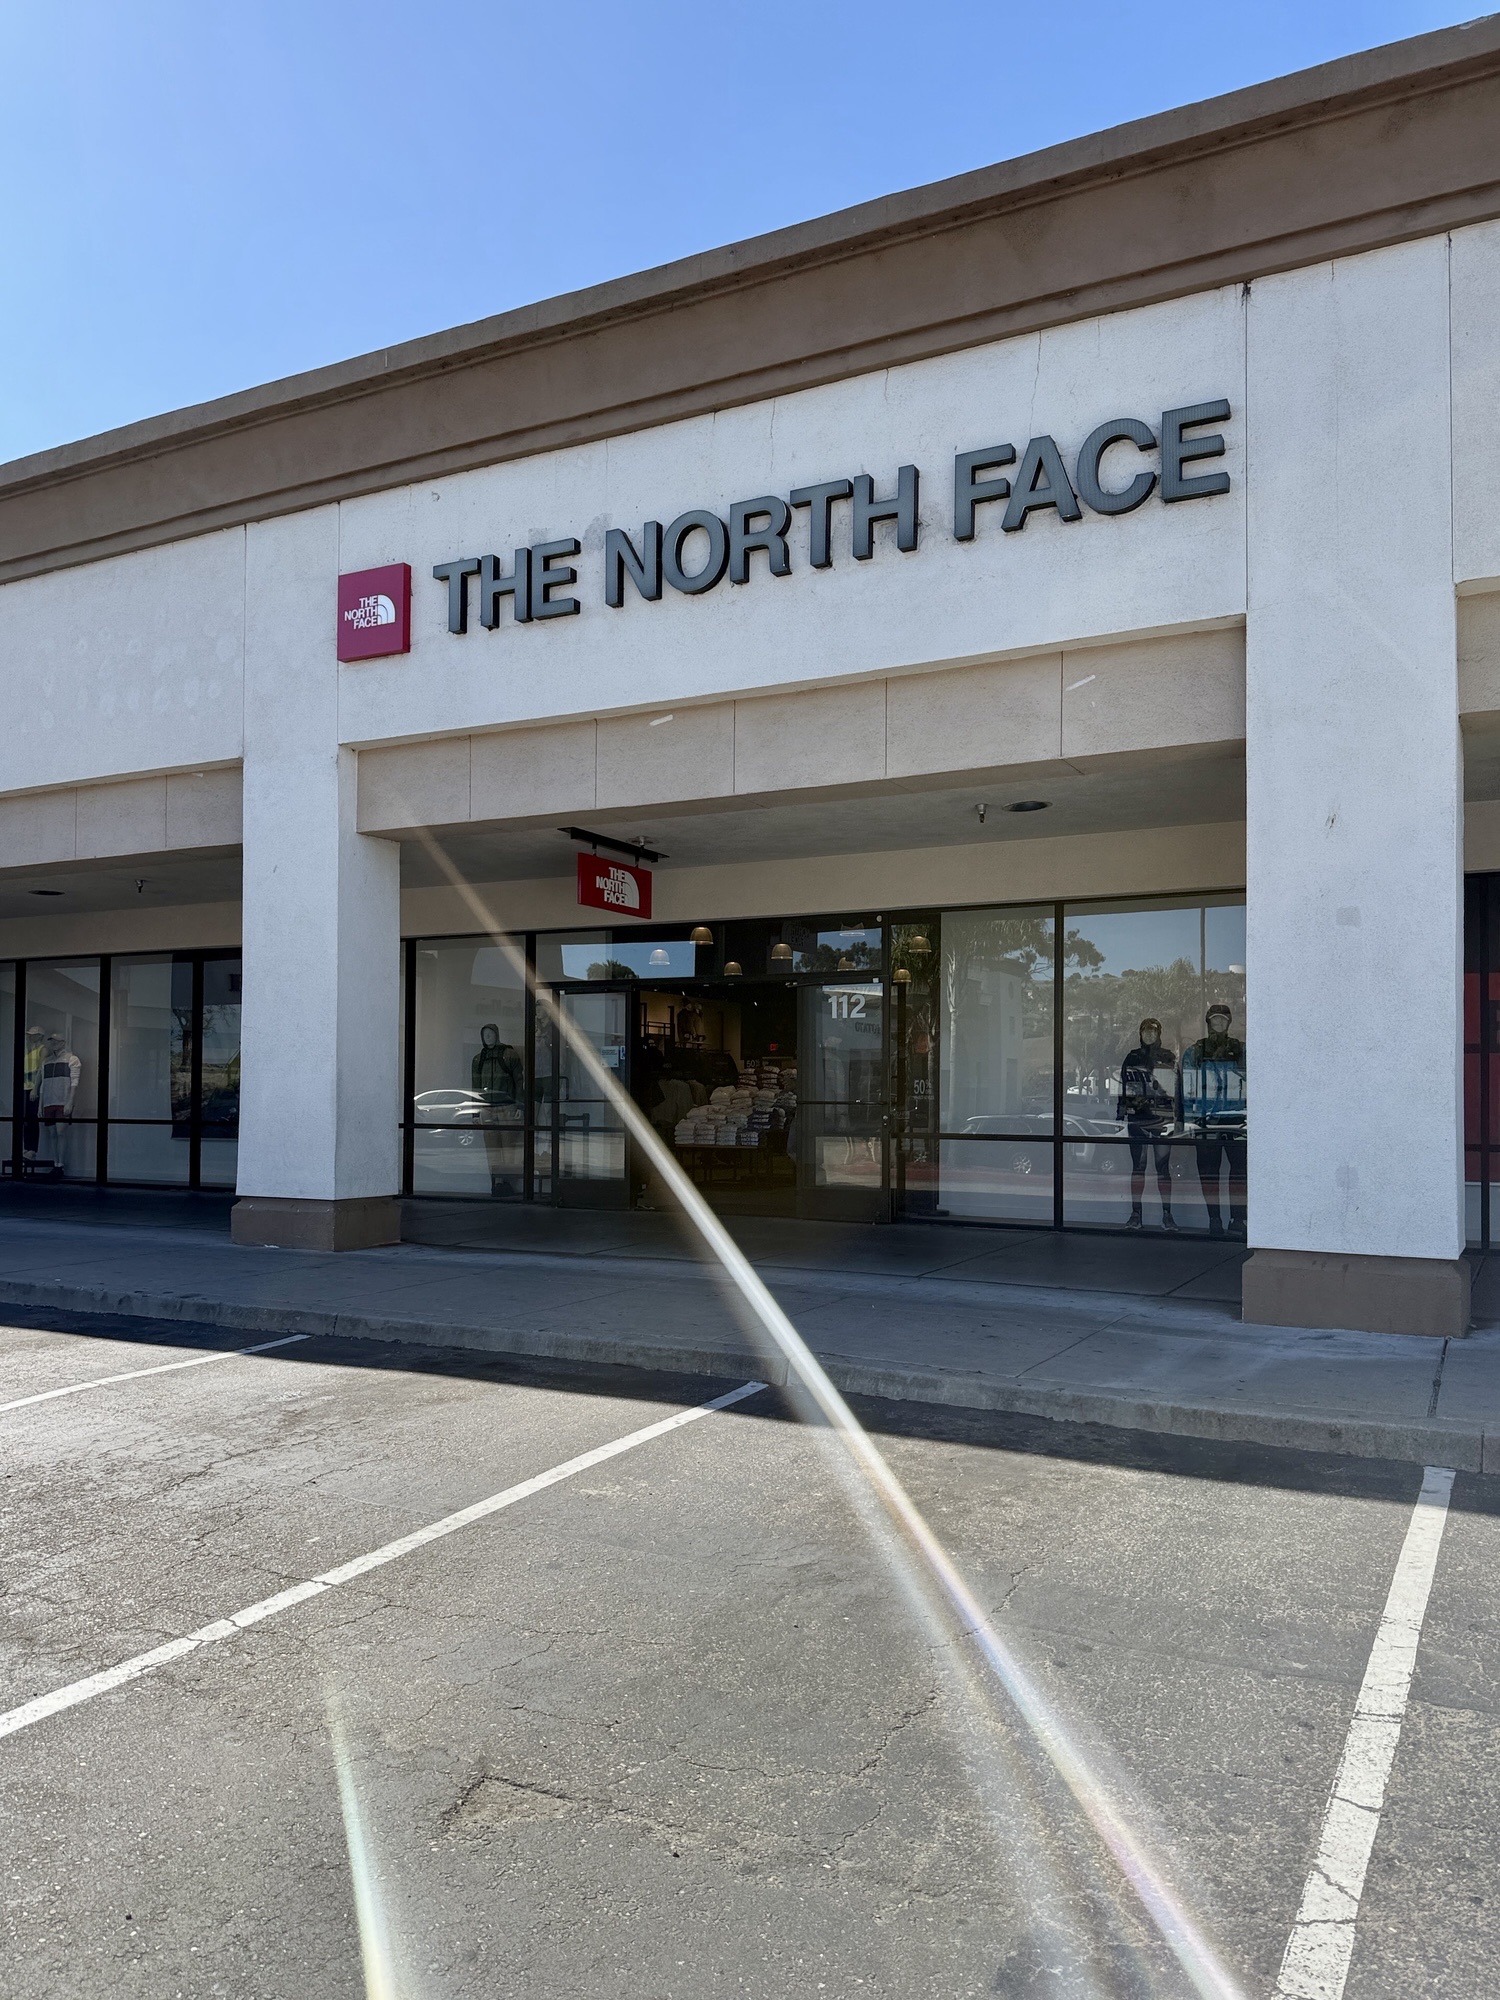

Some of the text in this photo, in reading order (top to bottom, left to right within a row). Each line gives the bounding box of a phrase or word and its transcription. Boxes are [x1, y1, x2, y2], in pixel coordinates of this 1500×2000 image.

[433, 398, 1231, 635] THE NORTH FACE
[359, 595, 378, 608] THE
[344, 605, 378, 621] NORTH
[353, 616, 378, 630] FACE
[608, 867, 626, 881] THE
[596, 875, 625, 894] NORTH
[604, 889, 626, 905] FACE
[828, 994, 867, 1019] 112
